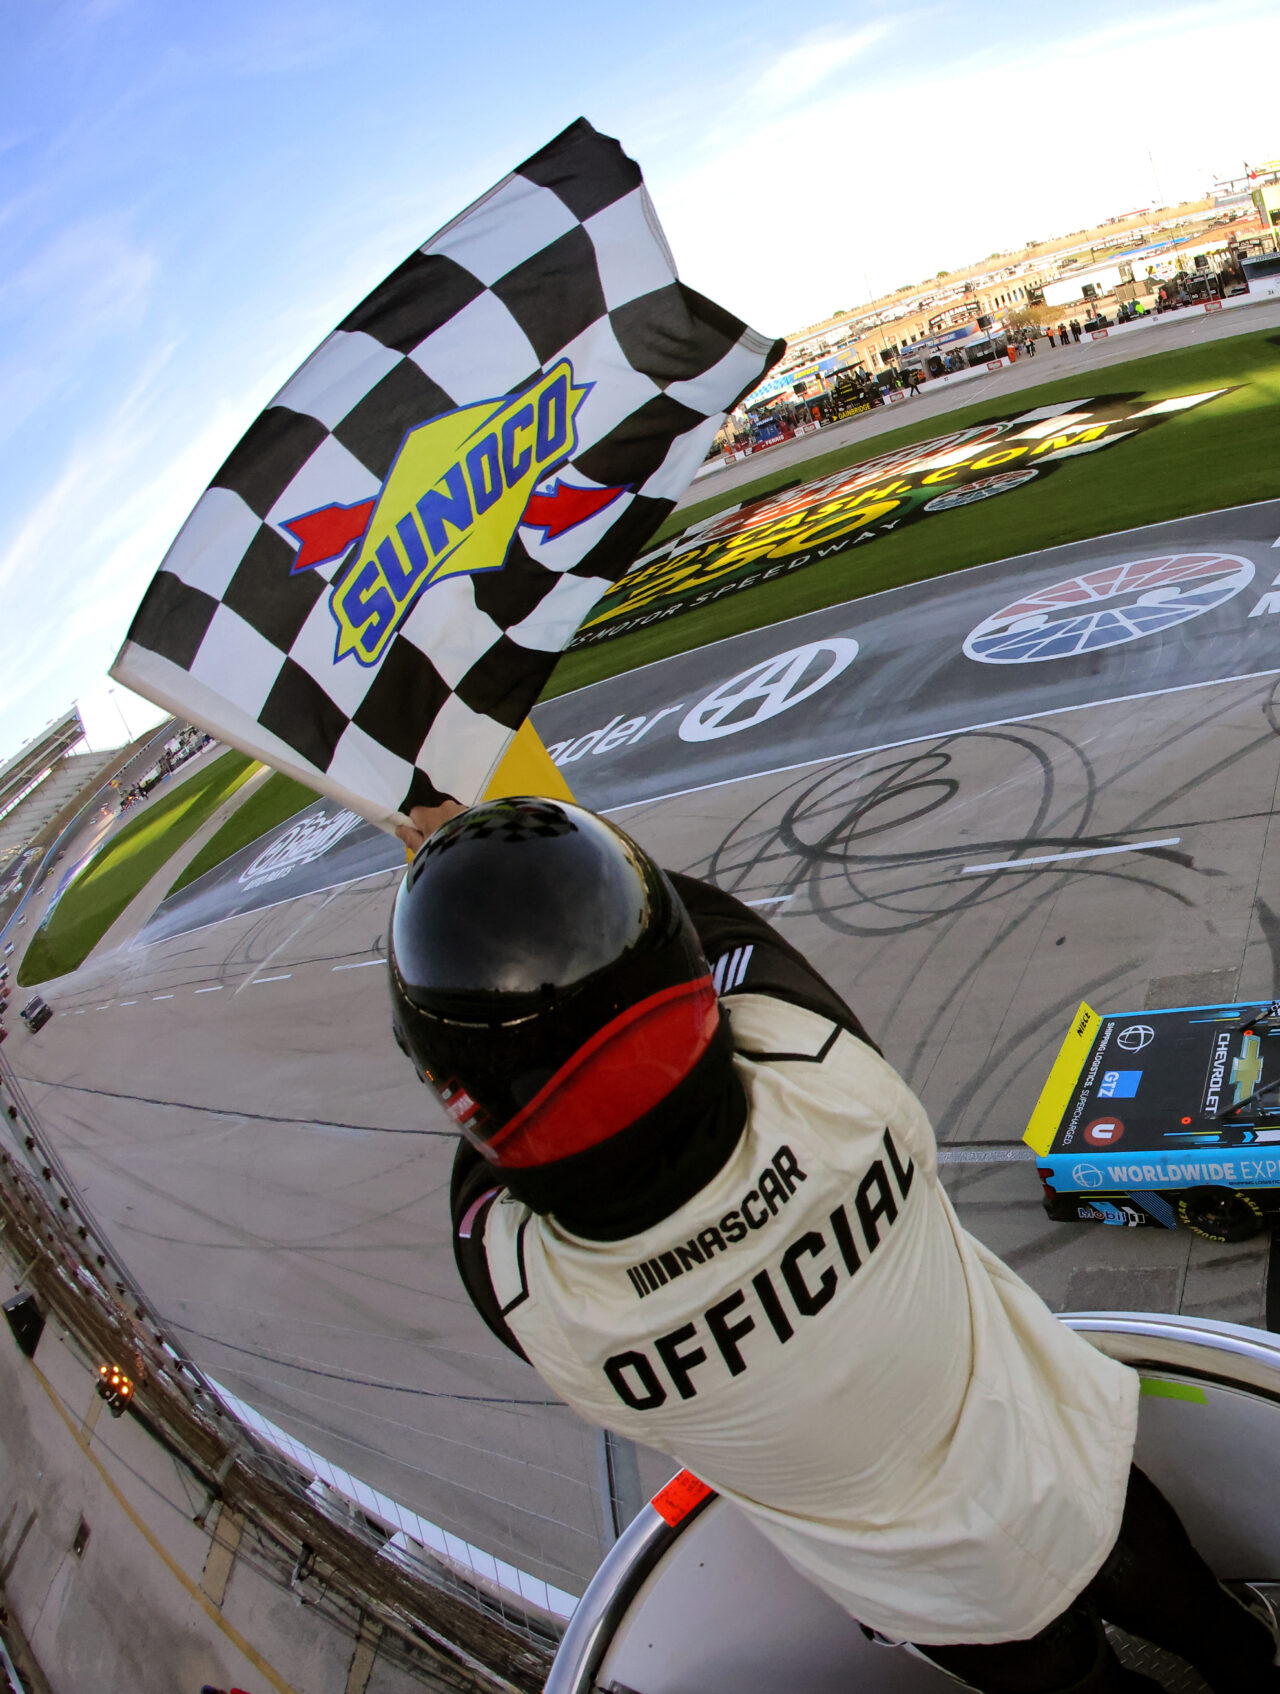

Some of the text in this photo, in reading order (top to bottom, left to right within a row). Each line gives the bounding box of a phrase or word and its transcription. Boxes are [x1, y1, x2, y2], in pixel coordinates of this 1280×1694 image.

[794, 365, 819, 380] SUNOCO
[342, 373, 568, 653] SUNOCO
[604, 424, 1110, 595] EEDYCASH.COM
[578, 500, 901, 631] 250
[689, 518, 902, 608] SPEEDWAY
[1077, 1011, 1092, 1038] NIECE
[1098, 1021, 1116, 1052] SHIPPING
[1099, 1071, 1120, 1098] GTZ
[1204, 1032, 1231, 1114] CHEVROLET
[658, 1144, 808, 1277] NASCAR
[1107, 1161, 1237, 1184] WORLDWIDE
[1077, 1207, 1126, 1222] Mobil
[602, 1126, 916, 1412] OFFICIAL
